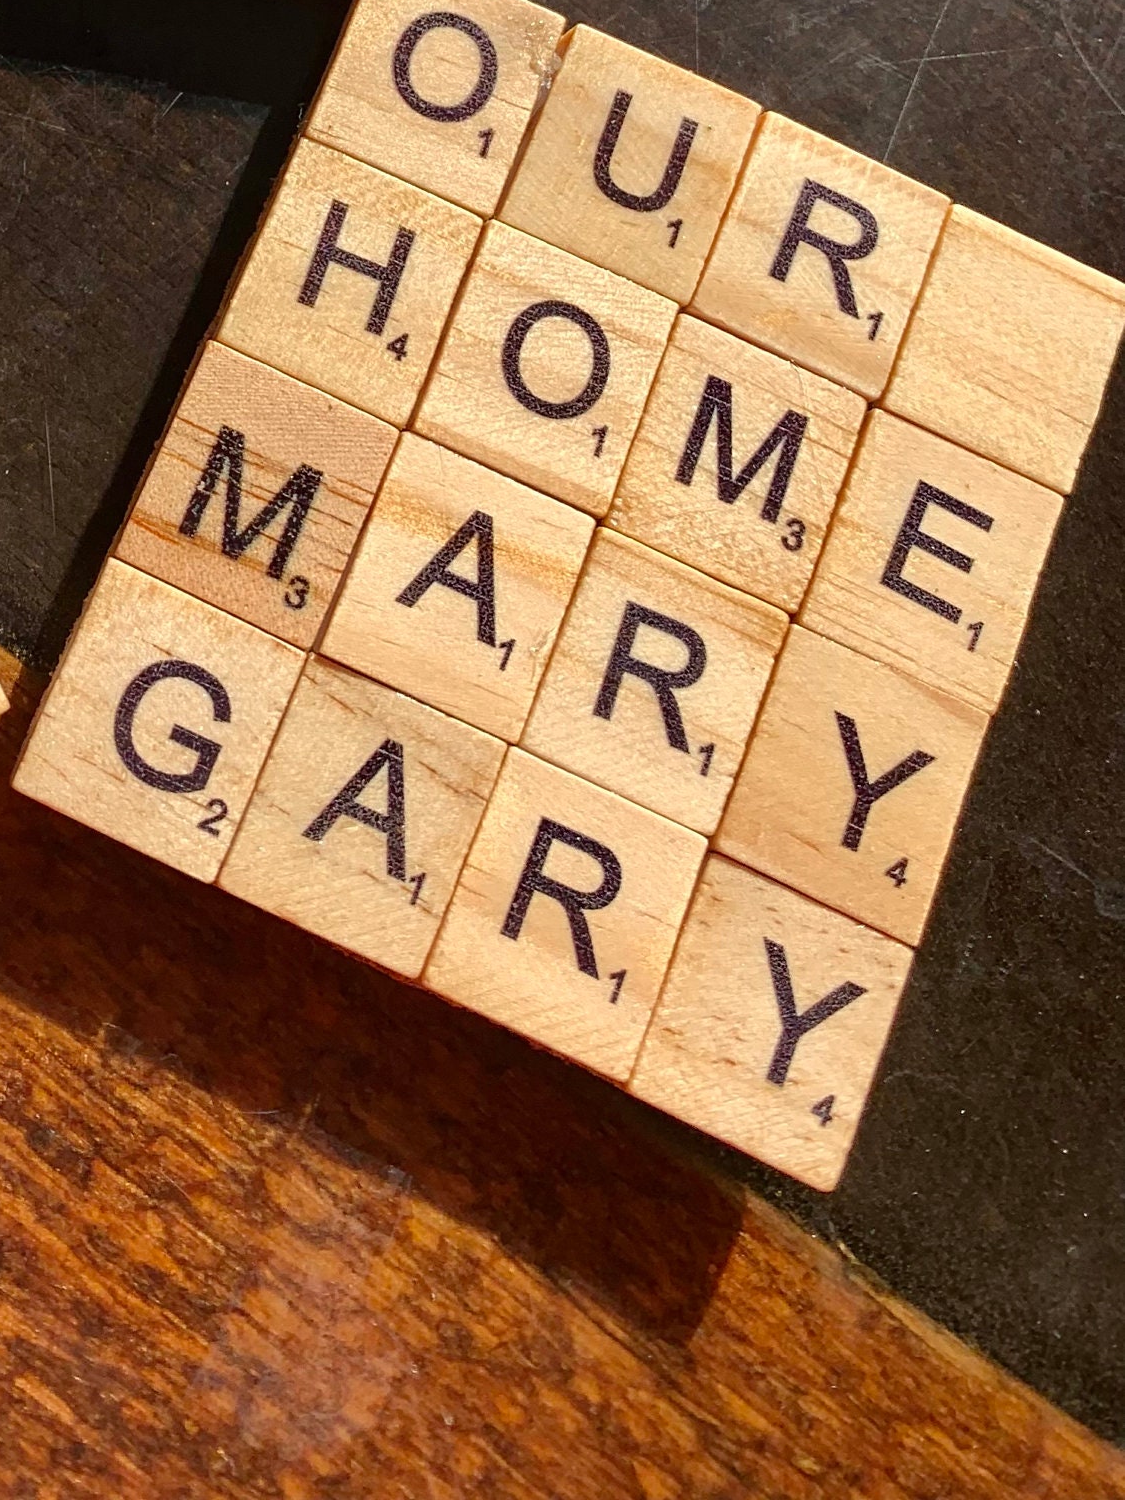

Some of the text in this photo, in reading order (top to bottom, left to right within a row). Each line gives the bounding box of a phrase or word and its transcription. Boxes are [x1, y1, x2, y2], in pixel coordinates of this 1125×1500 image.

[477, 127, 496, 160] 1
[391, 10, 880, 321] OUR
[666, 218, 684, 250] 1
[866, 311, 885, 342] 1
[385, 332, 410, 362] 4
[295, 197, 996, 626] HOME
[590, 424, 609, 459] 1
[780, 517, 807, 553] 3
[283, 574, 311, 612] 3
[177, 424, 937, 854] MARY
[498, 638, 517, 672] 1
[966, 621, 985, 653] 1
[698, 741, 717, 778] 1
[195, 797, 230, 839] 2
[112, 658, 870, 1089] GARY
[408, 871, 428, 907] 1
[884, 856, 909, 890] 4
[608, 968, 628, 1005] 1
[810, 1094, 836, 1128] 4
